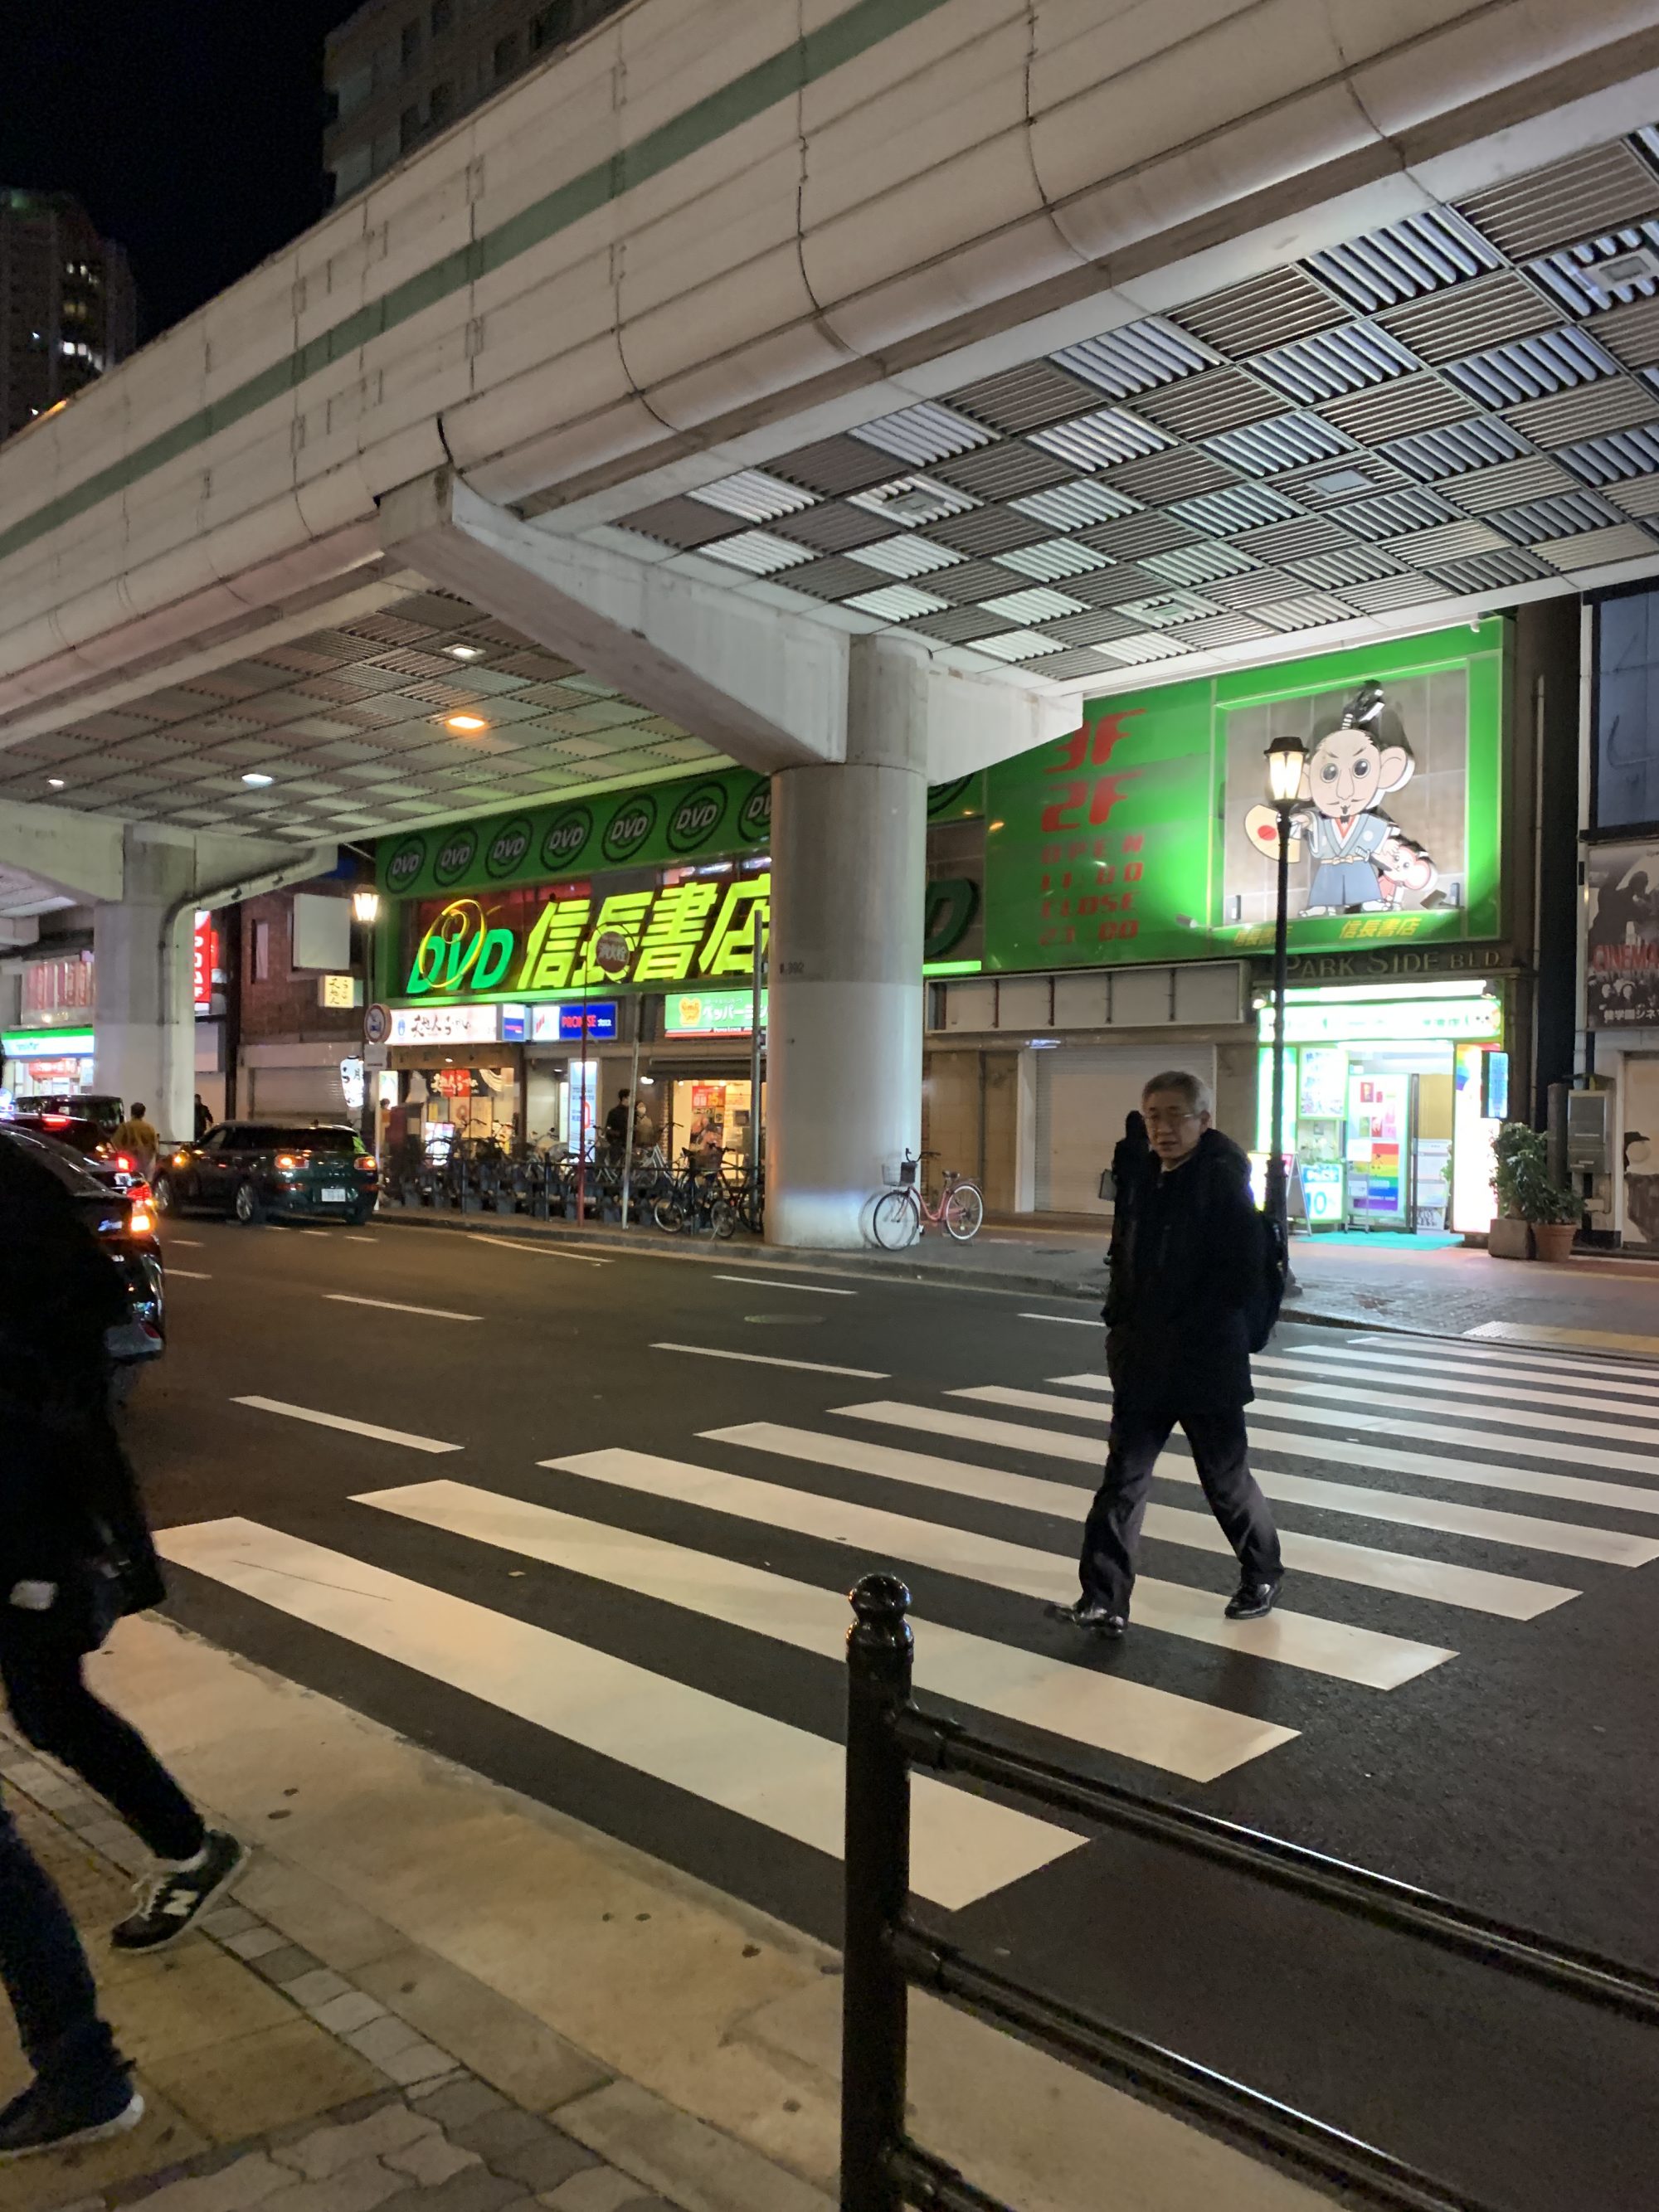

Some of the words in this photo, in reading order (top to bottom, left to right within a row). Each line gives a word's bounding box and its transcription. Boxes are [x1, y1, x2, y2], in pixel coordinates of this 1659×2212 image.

[1044, 707, 1146, 774] 3F
[748, 795, 771, 819] DV
[1041, 769, 1146, 832] 2F
[611, 815, 648, 841] DVD
[676, 805, 718, 830] DVD
[493, 837, 525, 858] DVD
[549, 827, 584, 850] DVD
[1041, 834, 1143, 865] OPEN
[392, 853, 420, 875] DVD
[440, 846, 470, 868] DVD
[1041, 890, 1141, 919] CLOSE
[406, 927, 513, 994] DVD
[516, 873, 771, 990] 信長書店
[1339, 917, 1422, 940] 信長書店
[1285, 954, 1354, 979] PARK
[1367, 952, 1439, 975] SIDE
[562, 1015, 596, 1028] PROMSE
